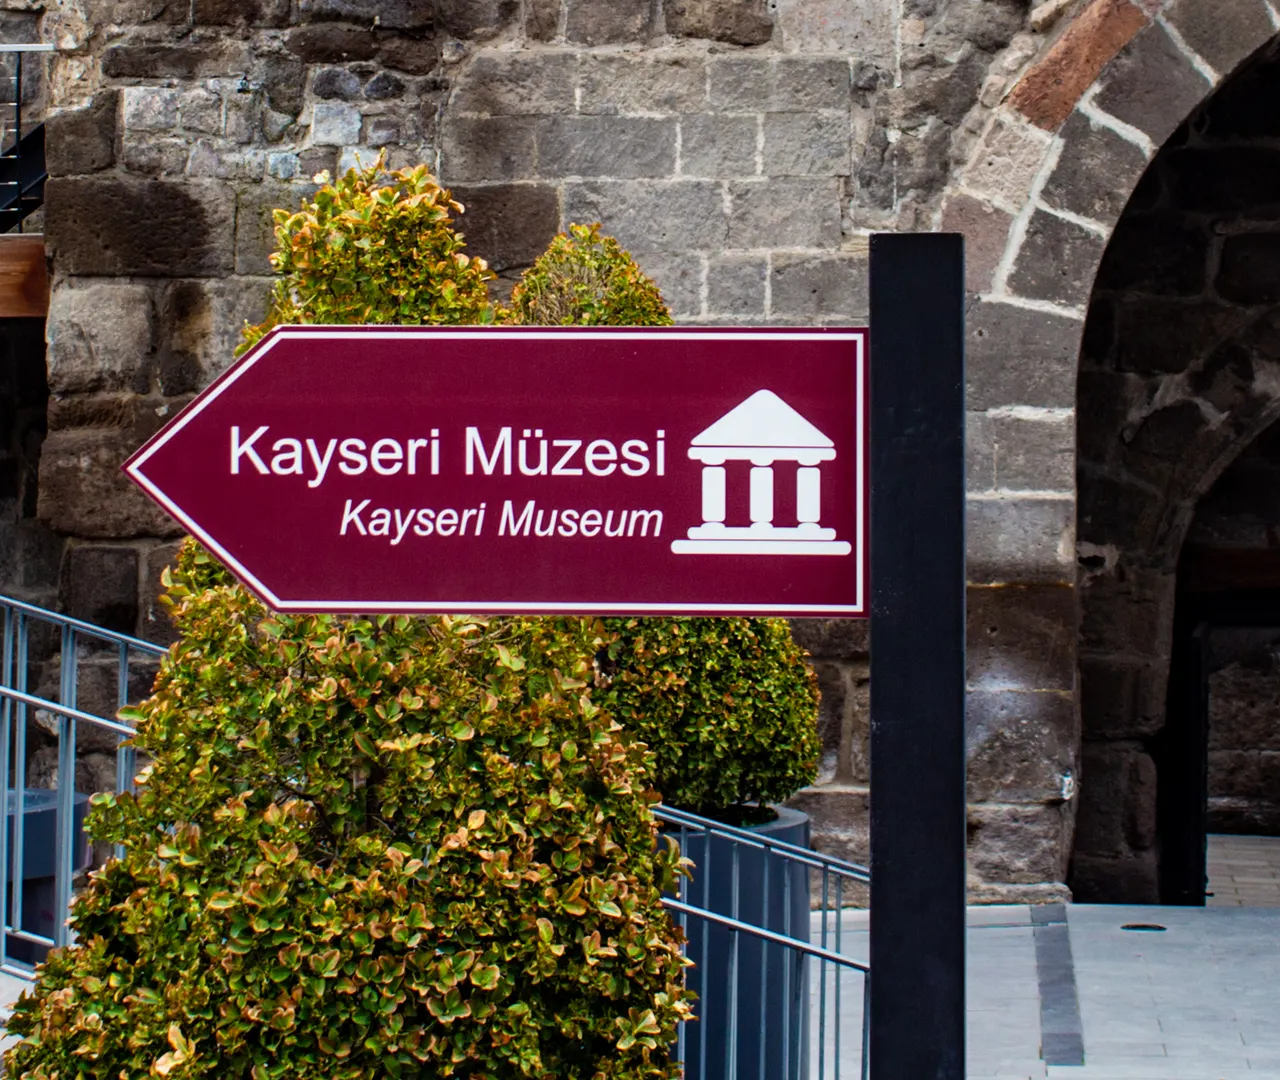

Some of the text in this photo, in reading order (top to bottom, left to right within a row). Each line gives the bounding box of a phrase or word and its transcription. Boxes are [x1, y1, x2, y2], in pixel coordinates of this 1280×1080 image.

[230, 425, 665, 488] Kayseri Müzesi
[339, 499, 663, 546] Kayseri Museum
